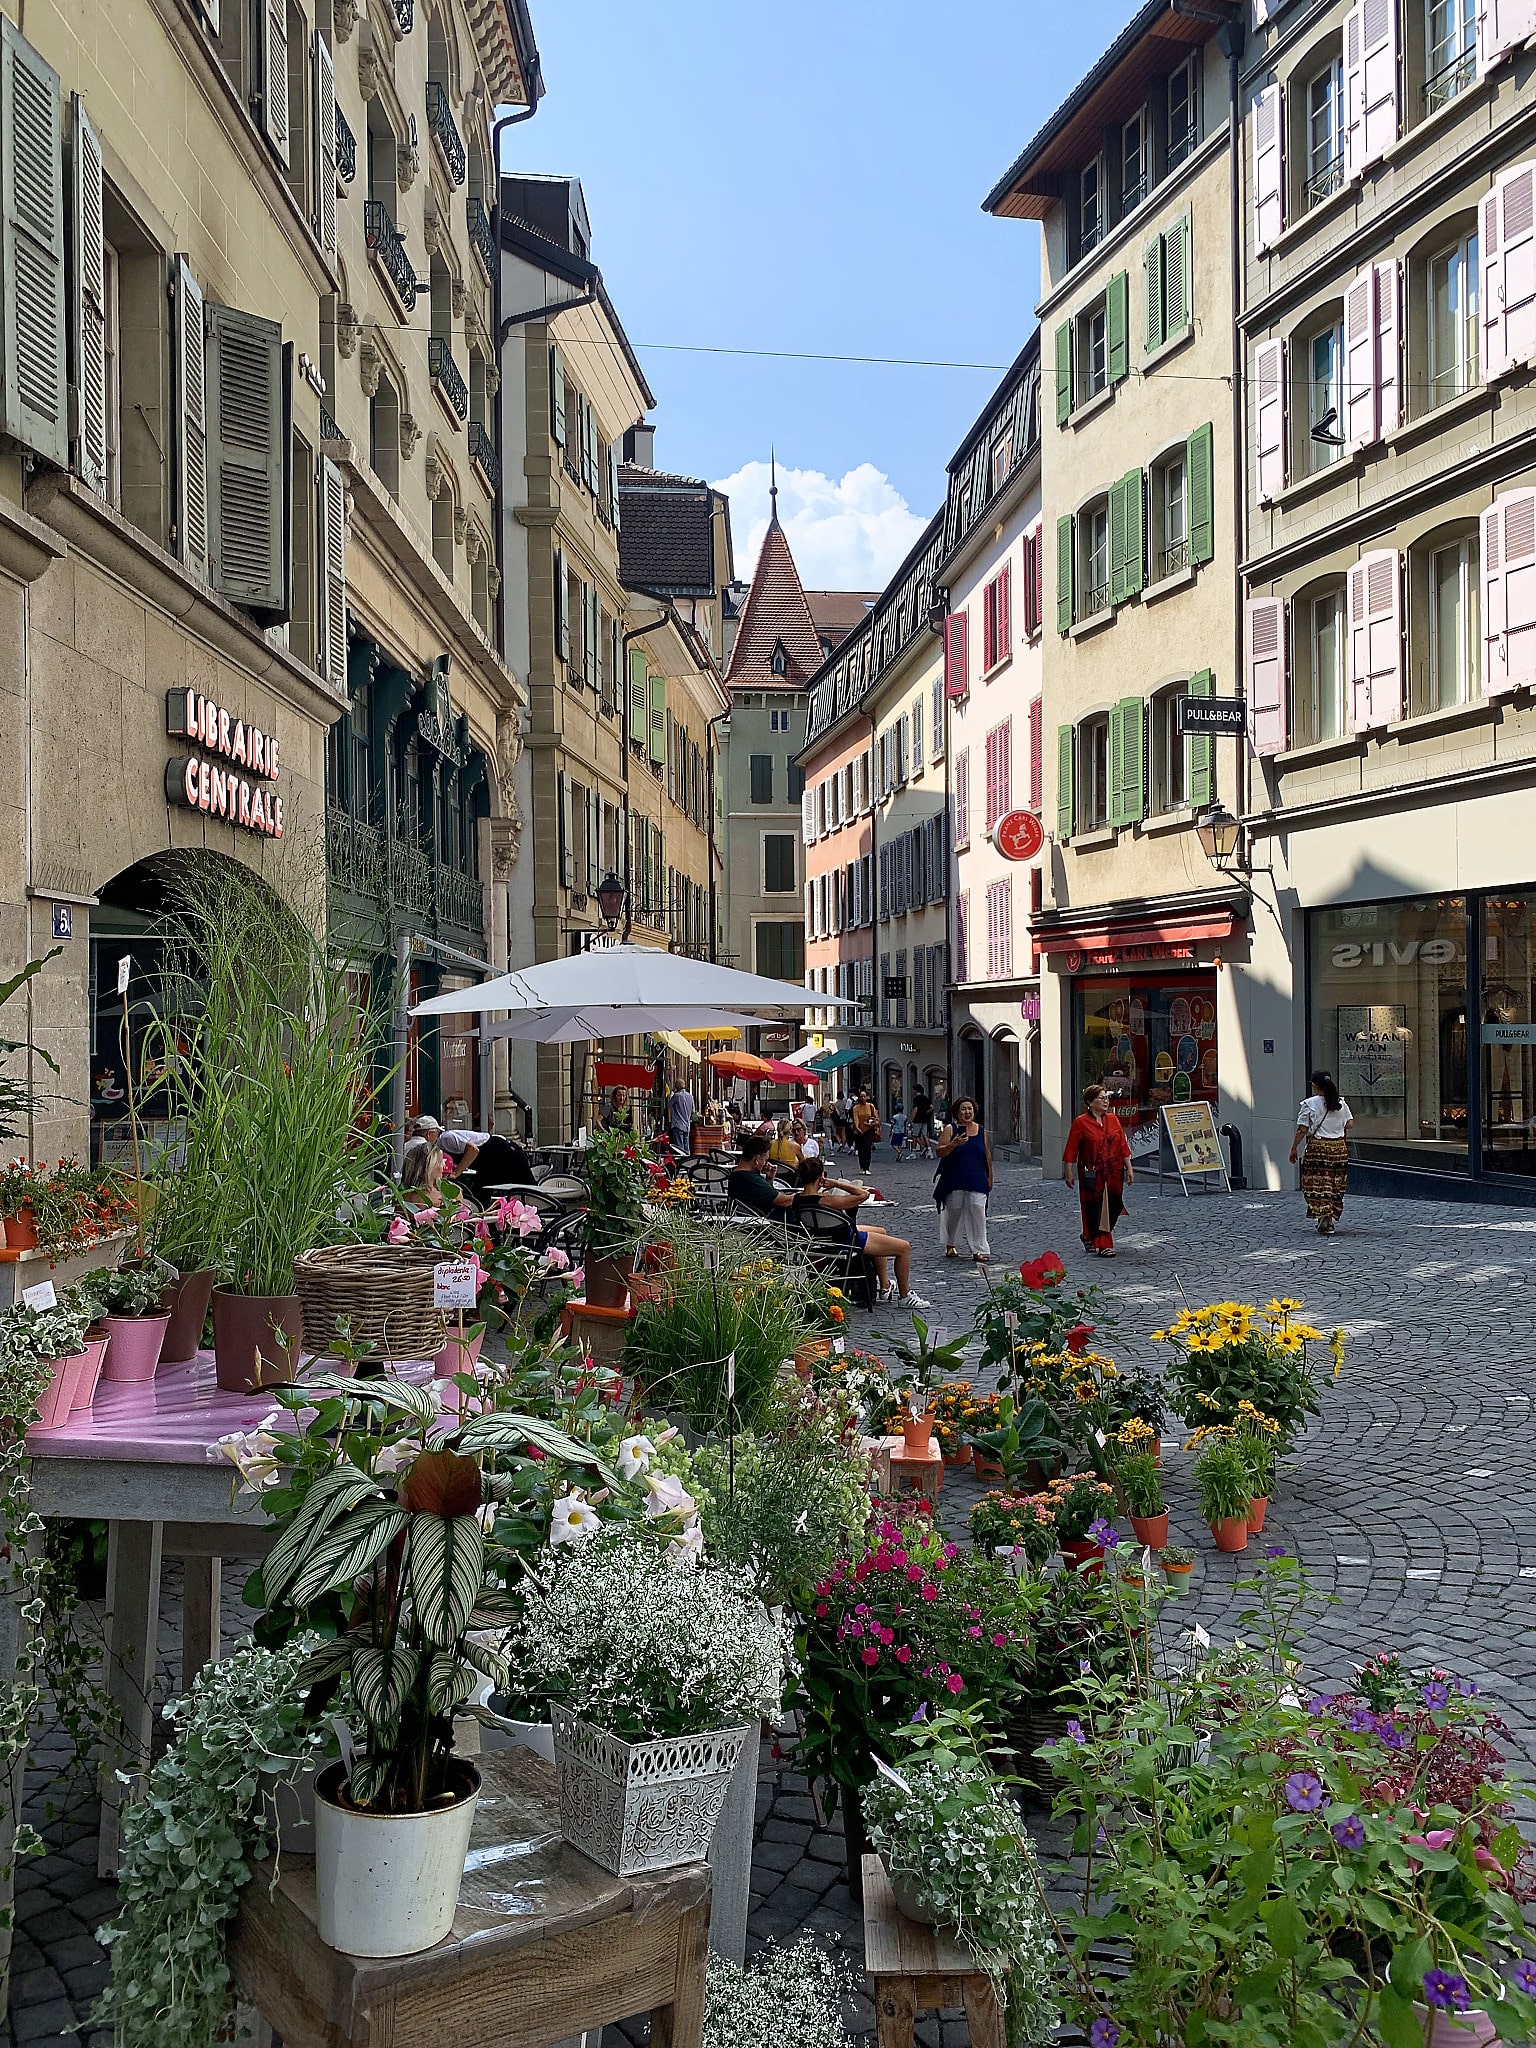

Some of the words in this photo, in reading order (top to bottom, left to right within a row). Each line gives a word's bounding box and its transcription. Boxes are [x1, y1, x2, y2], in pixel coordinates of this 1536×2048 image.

[1187, 709, 1241, 722] PULL&BEAR
[186, 687, 279, 781] LIBRAIRIE
[185, 757, 283, 839] CENTRALE
[60, 908, 69, 933] 5
[1495, 1029, 1530, 1038] PULL&BEAR
[1355, 1043, 1387, 1052] MAN
[1118, 1106, 1137, 1116] LEGO
